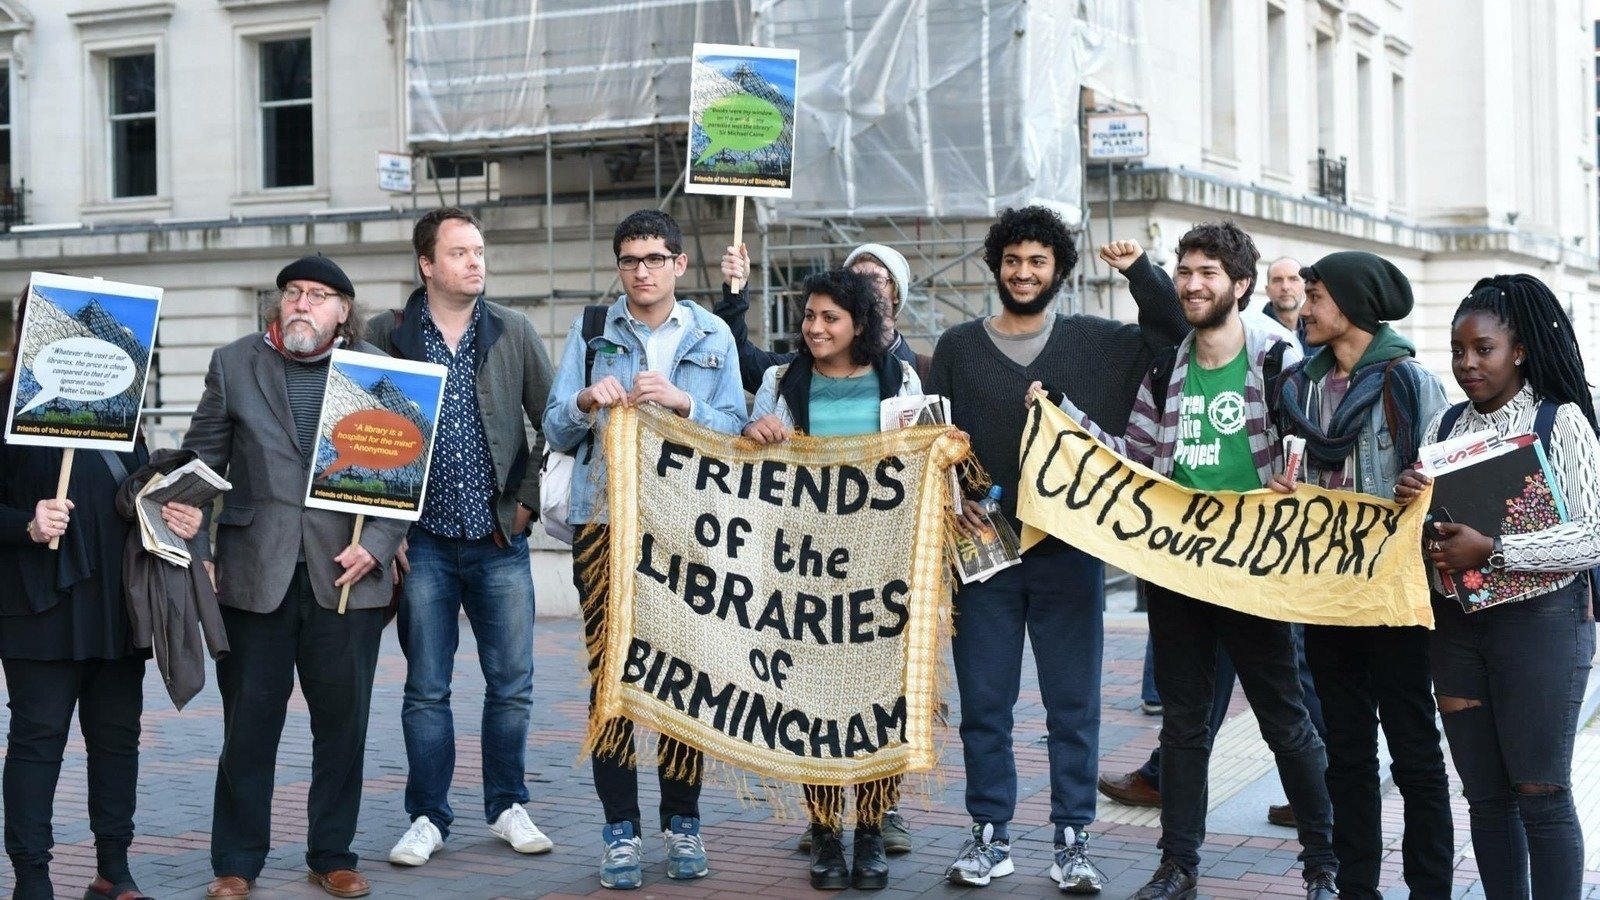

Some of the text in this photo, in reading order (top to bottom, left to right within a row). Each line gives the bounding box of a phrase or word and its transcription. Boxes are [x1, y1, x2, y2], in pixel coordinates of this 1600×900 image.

[730, 177, 748, 185] Library
[52, 347, 82, 356] "Whatever
[80, 388, 105, 396] Cronkite
[1180, 395, 1204, 414] reen
[17, 425, 40, 433] Friends
[60, 428, 82, 437] Library
[90, 430, 128, 439] Birmingham
[337, 431, 367, 442] hospital
[380, 437, 393, 445] the
[394, 440, 417, 448] mind"
[364, 425, 388, 436] library
[389, 427, 396, 436] is
[353, 443, 398, 456] Anonymous
[1174, 438, 1220, 470] Project
[656, 439, 906, 515] FRIENDS
[315, 490, 336, 499] Friends
[354, 494, 373, 504] Library
[380, 498, 414, 509] Birmingham
[1182, 492, 1224, 531] TO
[1148, 526, 1217, 566] OUR
[1212, 494, 1406, 582] LIBRARY
[773, 528, 850, 579] the
[636, 532, 910, 646] LIBRARIES
[621, 636, 908, 758] BIRMINGHAM
